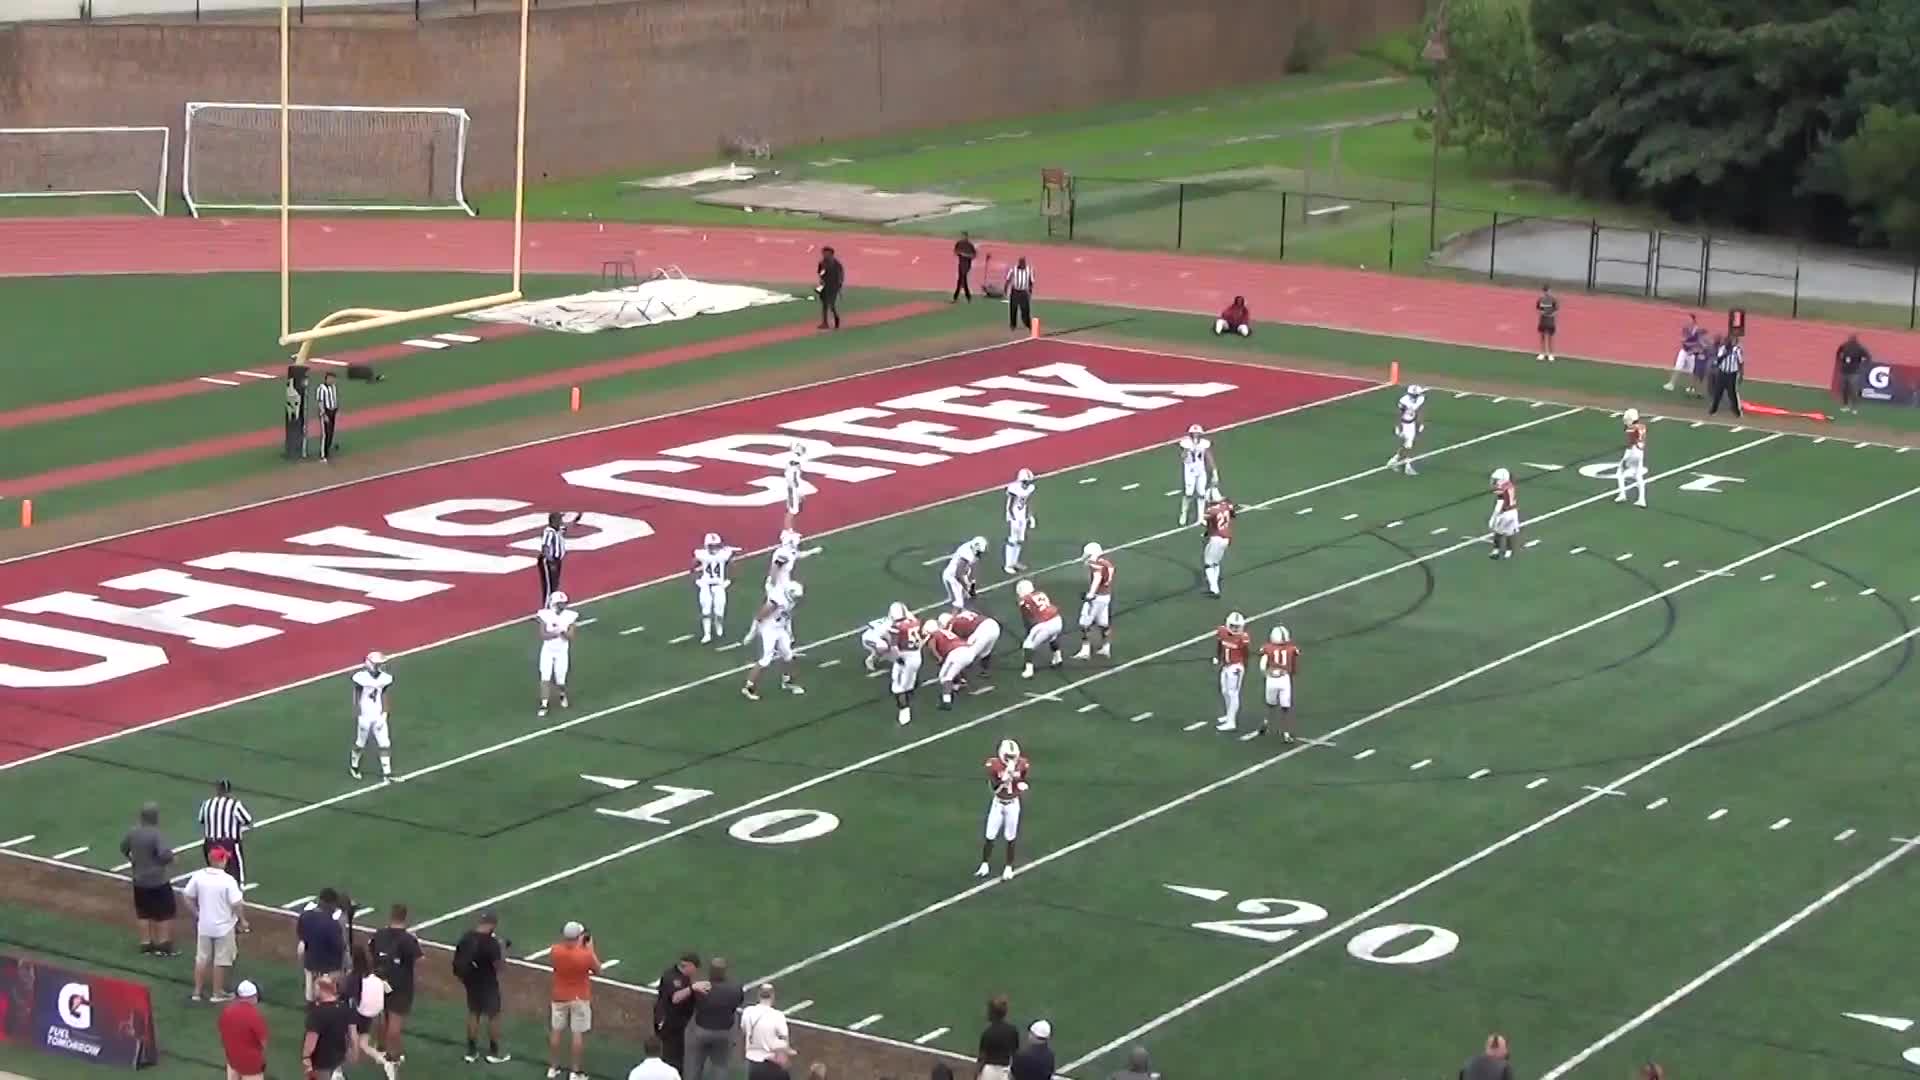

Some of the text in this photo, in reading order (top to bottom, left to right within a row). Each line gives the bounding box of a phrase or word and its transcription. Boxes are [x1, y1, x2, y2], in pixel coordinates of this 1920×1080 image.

[1868, 366, 1890, 388] G
[561, 361, 1239, 507] CREEK
[705, 562, 721, 578] 44
[1273, 649, 1287, 666] 11
[594, 785, 841, 844] 10
[1190, 897, 1461, 964] 20
[59, 983, 91, 1028] G
[49, 1026, 69, 1038] FUEL
[48, 1037, 101, 1056] TOMORROW
